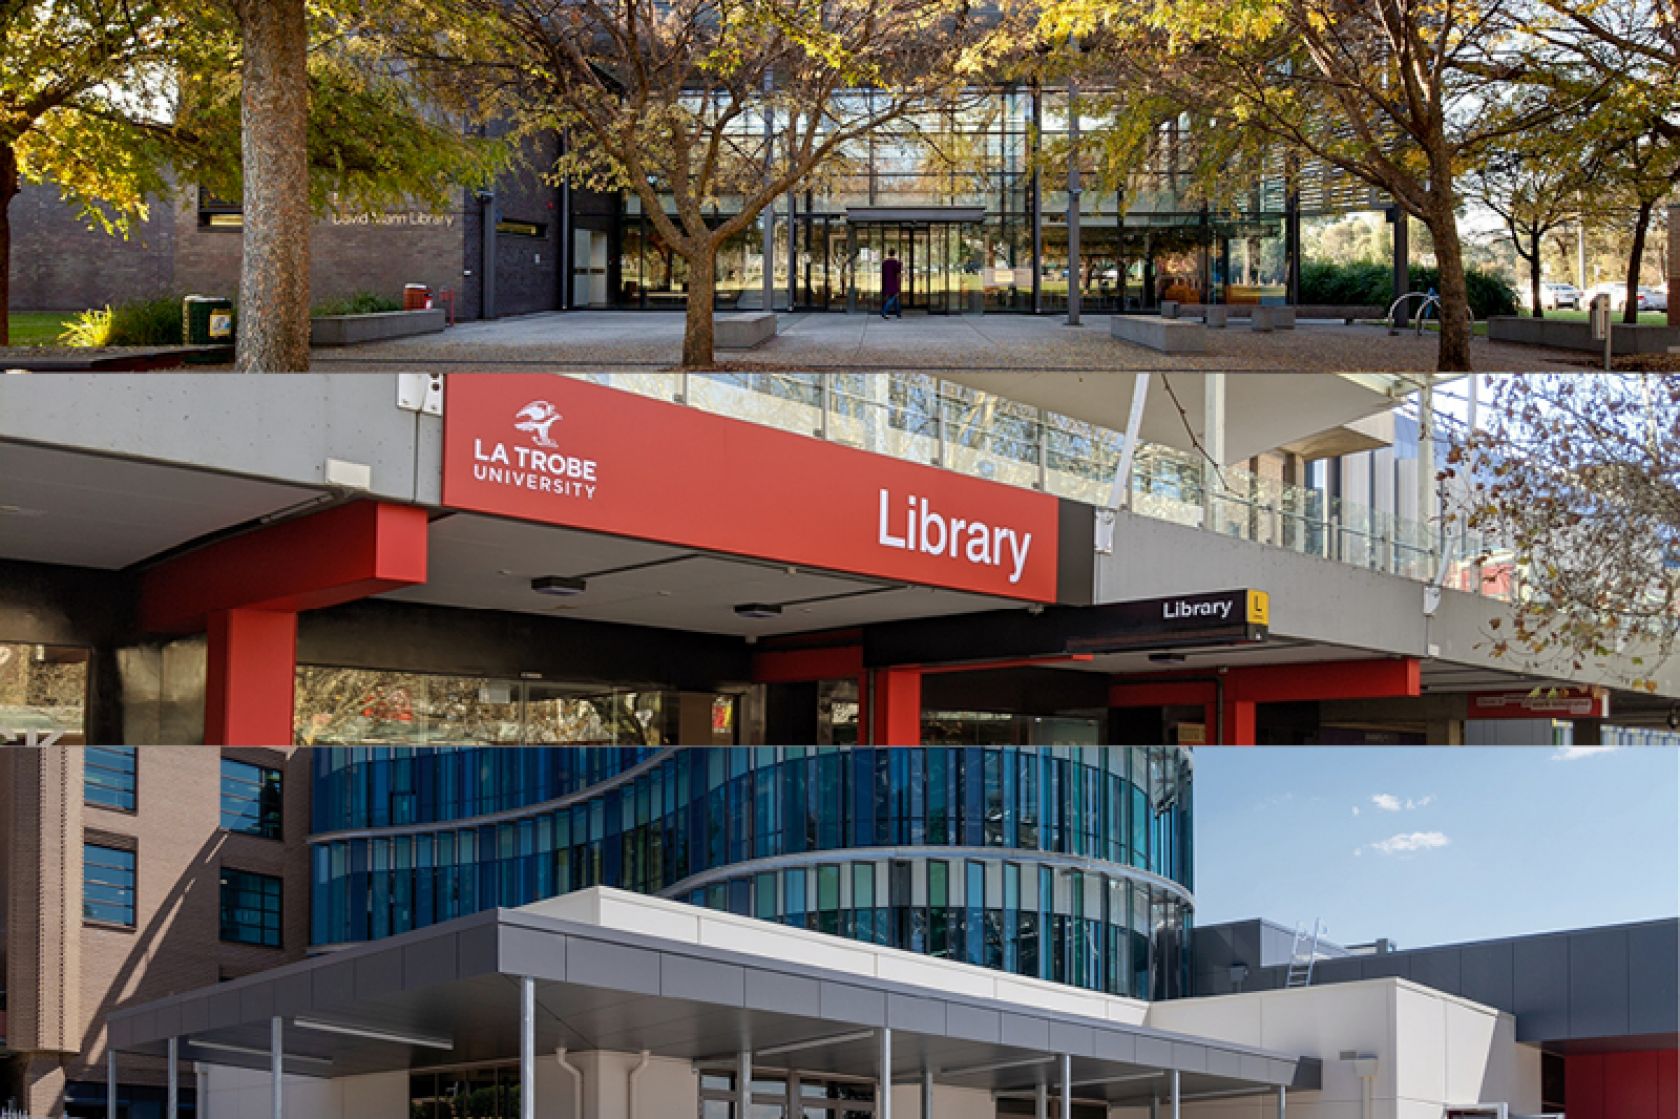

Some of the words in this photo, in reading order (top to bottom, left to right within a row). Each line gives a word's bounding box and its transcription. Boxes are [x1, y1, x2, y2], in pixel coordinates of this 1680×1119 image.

[409, 211, 455, 228] Library
[474, 438, 509, 465] LA
[514, 446, 597, 482] TROBE
[473, 463, 597, 500] UNIVERSITY
[879, 488, 1032, 584] Library
[1162, 600, 1234, 619] Library
